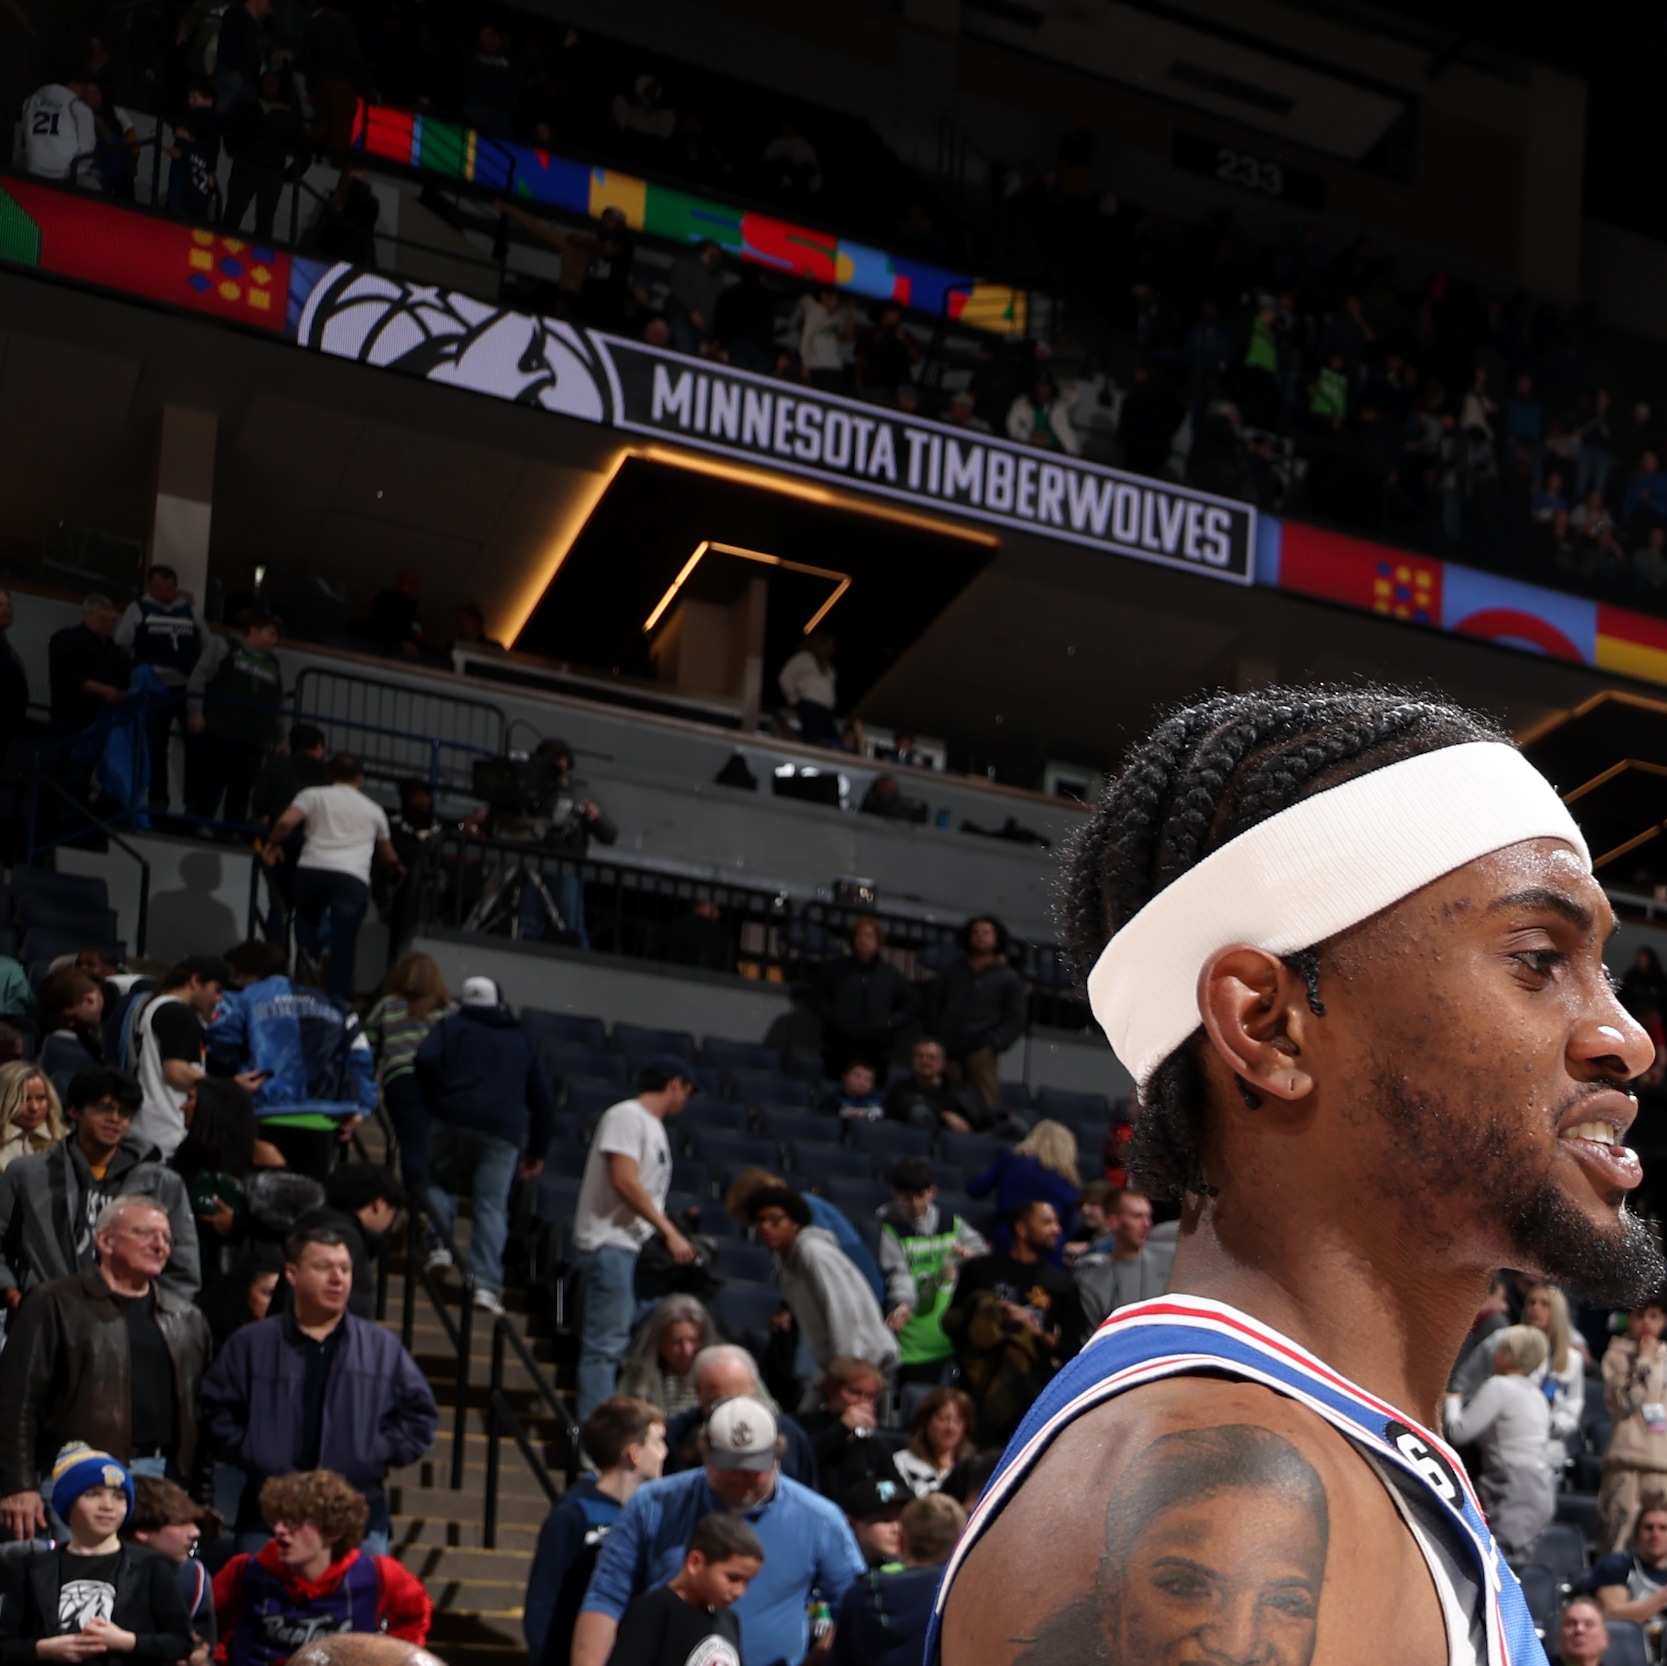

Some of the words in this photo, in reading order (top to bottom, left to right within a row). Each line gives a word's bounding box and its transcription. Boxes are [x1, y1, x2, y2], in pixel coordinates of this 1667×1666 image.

[651, 362, 898, 483] MINNESOTA
[904, 425, 1232, 568] TIMBERWOLVES
[1397, 1433, 1456, 1500] 6
